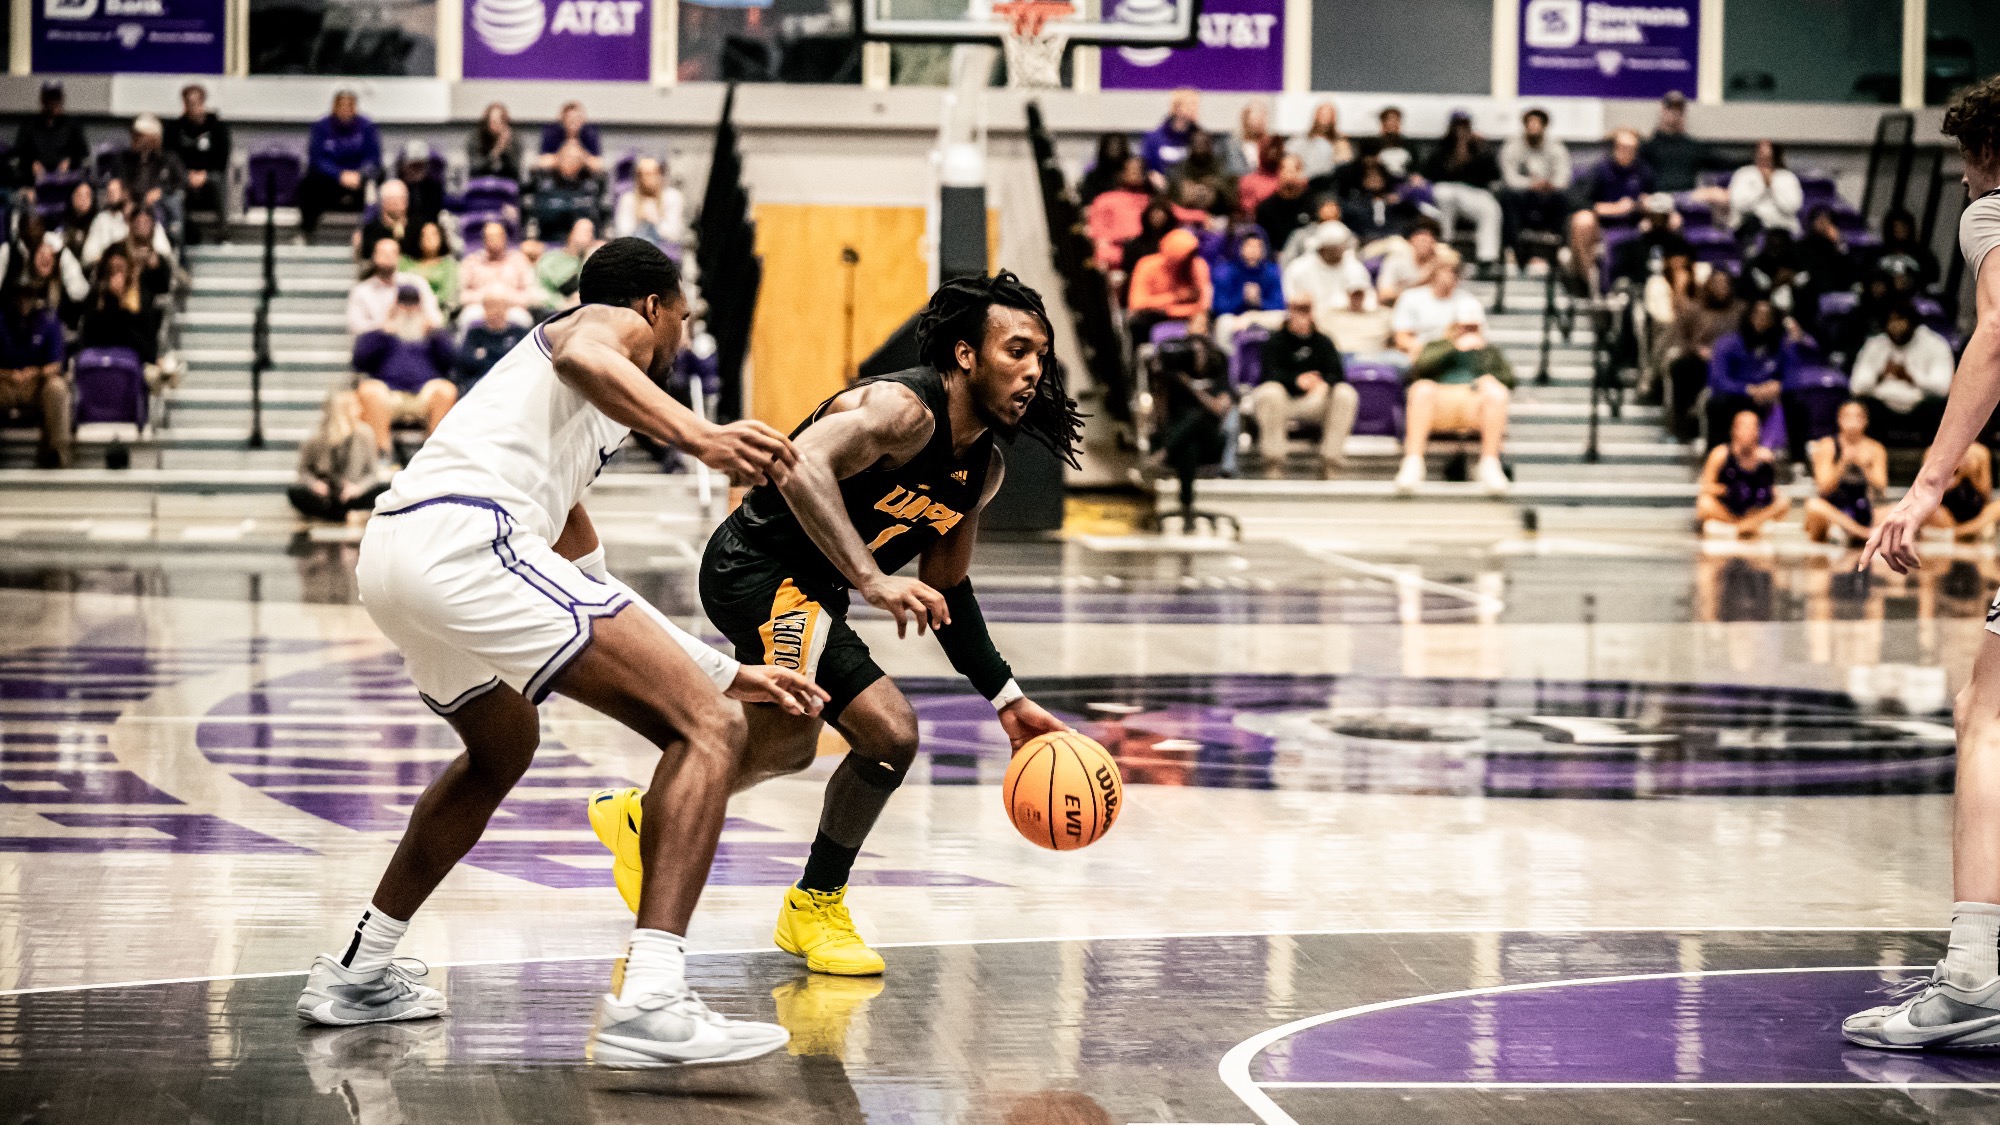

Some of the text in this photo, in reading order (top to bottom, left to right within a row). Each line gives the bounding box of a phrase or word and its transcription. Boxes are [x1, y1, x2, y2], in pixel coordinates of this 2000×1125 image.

[551, 0, 644, 36] AT&T
[772, 610, 809, 670] OLDEN
[1064, 794, 1082, 837] EVO
